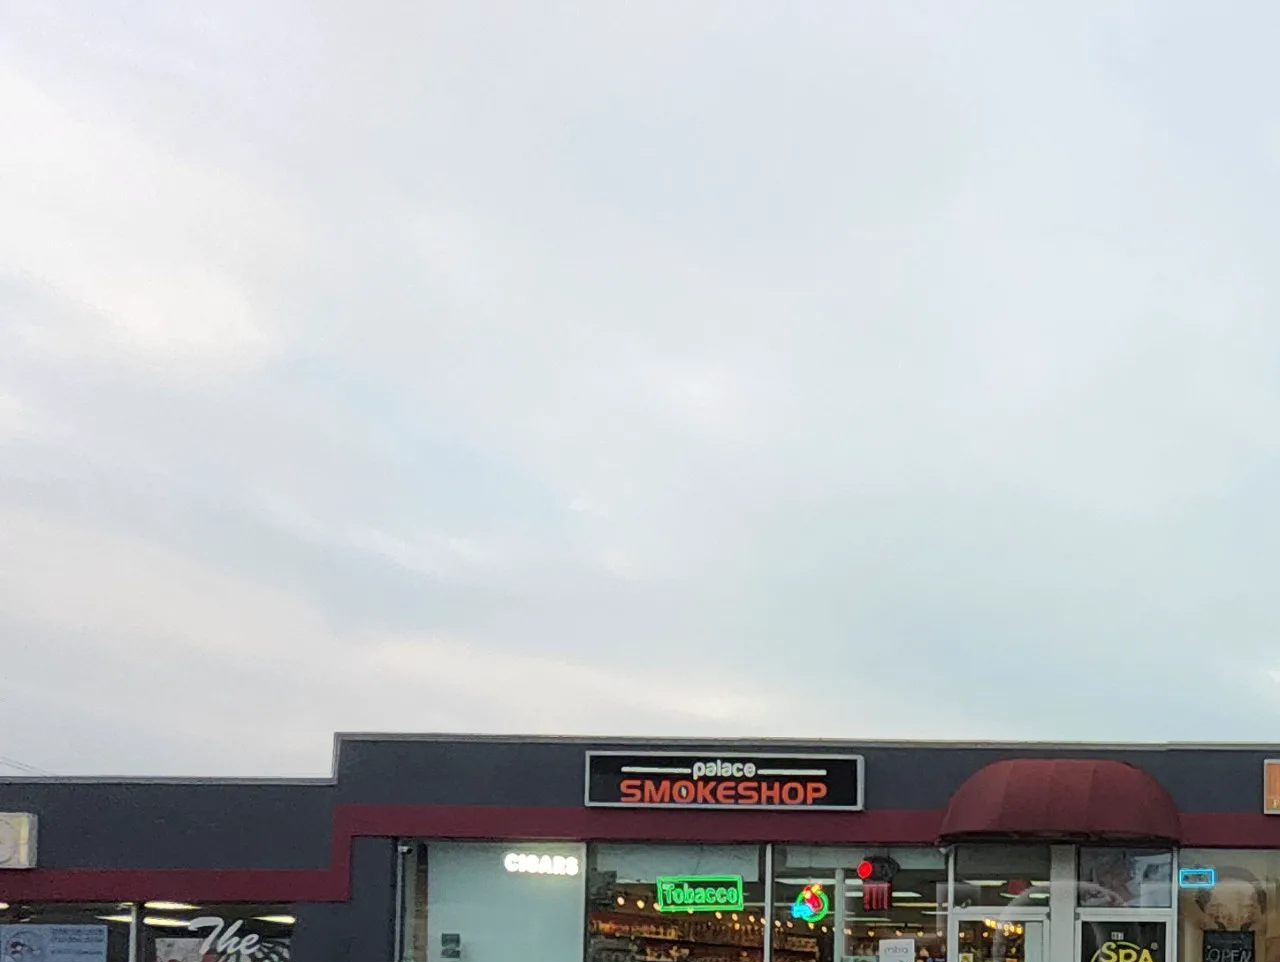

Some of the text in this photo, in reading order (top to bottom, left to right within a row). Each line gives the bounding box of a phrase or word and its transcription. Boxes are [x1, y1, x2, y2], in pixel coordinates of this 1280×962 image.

[692, 759, 756, 780] palace
[620, 779, 827, 804] SMOKESHOP
[504, 852, 579, 876] CIGARS
[661, 881, 738, 904] Tobacco
[187, 916, 261, 955] The
